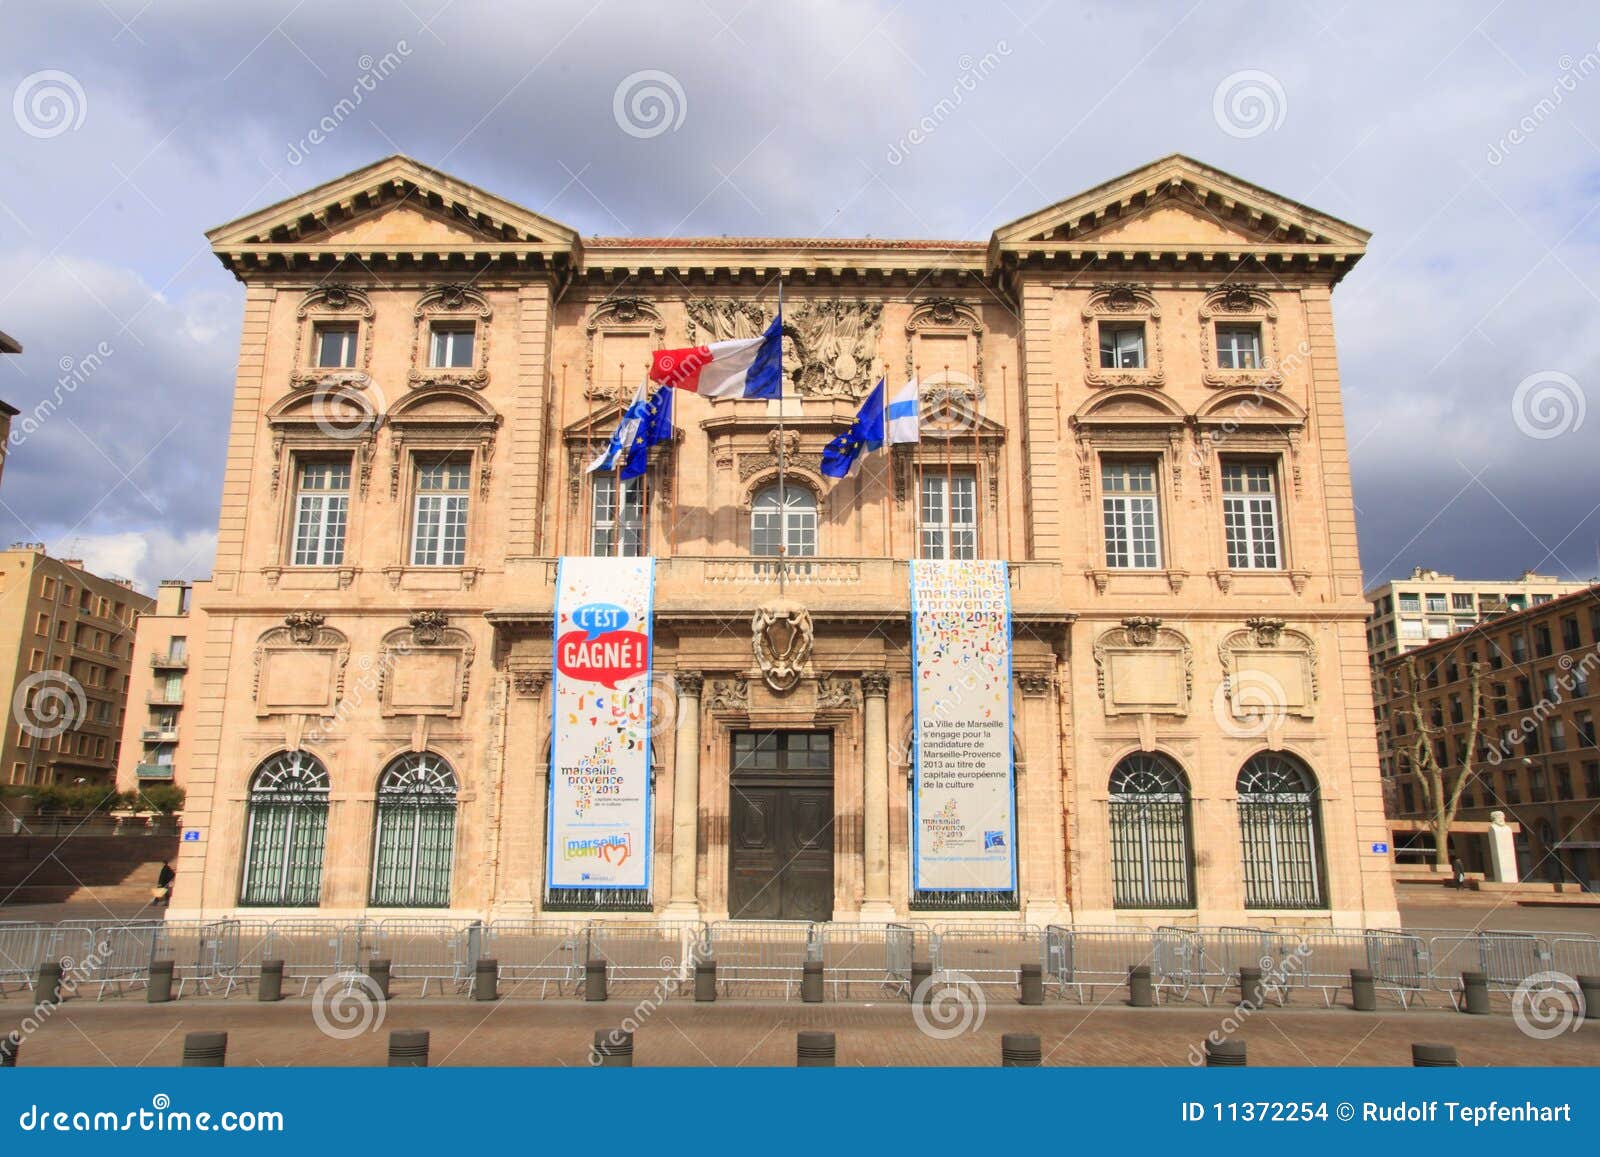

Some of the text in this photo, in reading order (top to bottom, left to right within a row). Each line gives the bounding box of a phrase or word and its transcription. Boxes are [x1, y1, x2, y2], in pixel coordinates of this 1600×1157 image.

[919, 587, 992, 599] marseille
[928, 600, 1002, 612] provence
[580, 606, 620, 628] C'EST
[966, 611, 997, 622] 2013
[563, 637, 632, 669] GAGNÉ
[923, 720, 1004, 728] La Ville de Marseille
[923, 731, 961, 739] s'engage
[561, 765, 617, 775] marseille
[923, 771, 1006, 780] capitale européenne
[568, 776, 624, 786] provence
[596, 785, 620, 794] 2013
[567, 835, 626, 849] marseille
